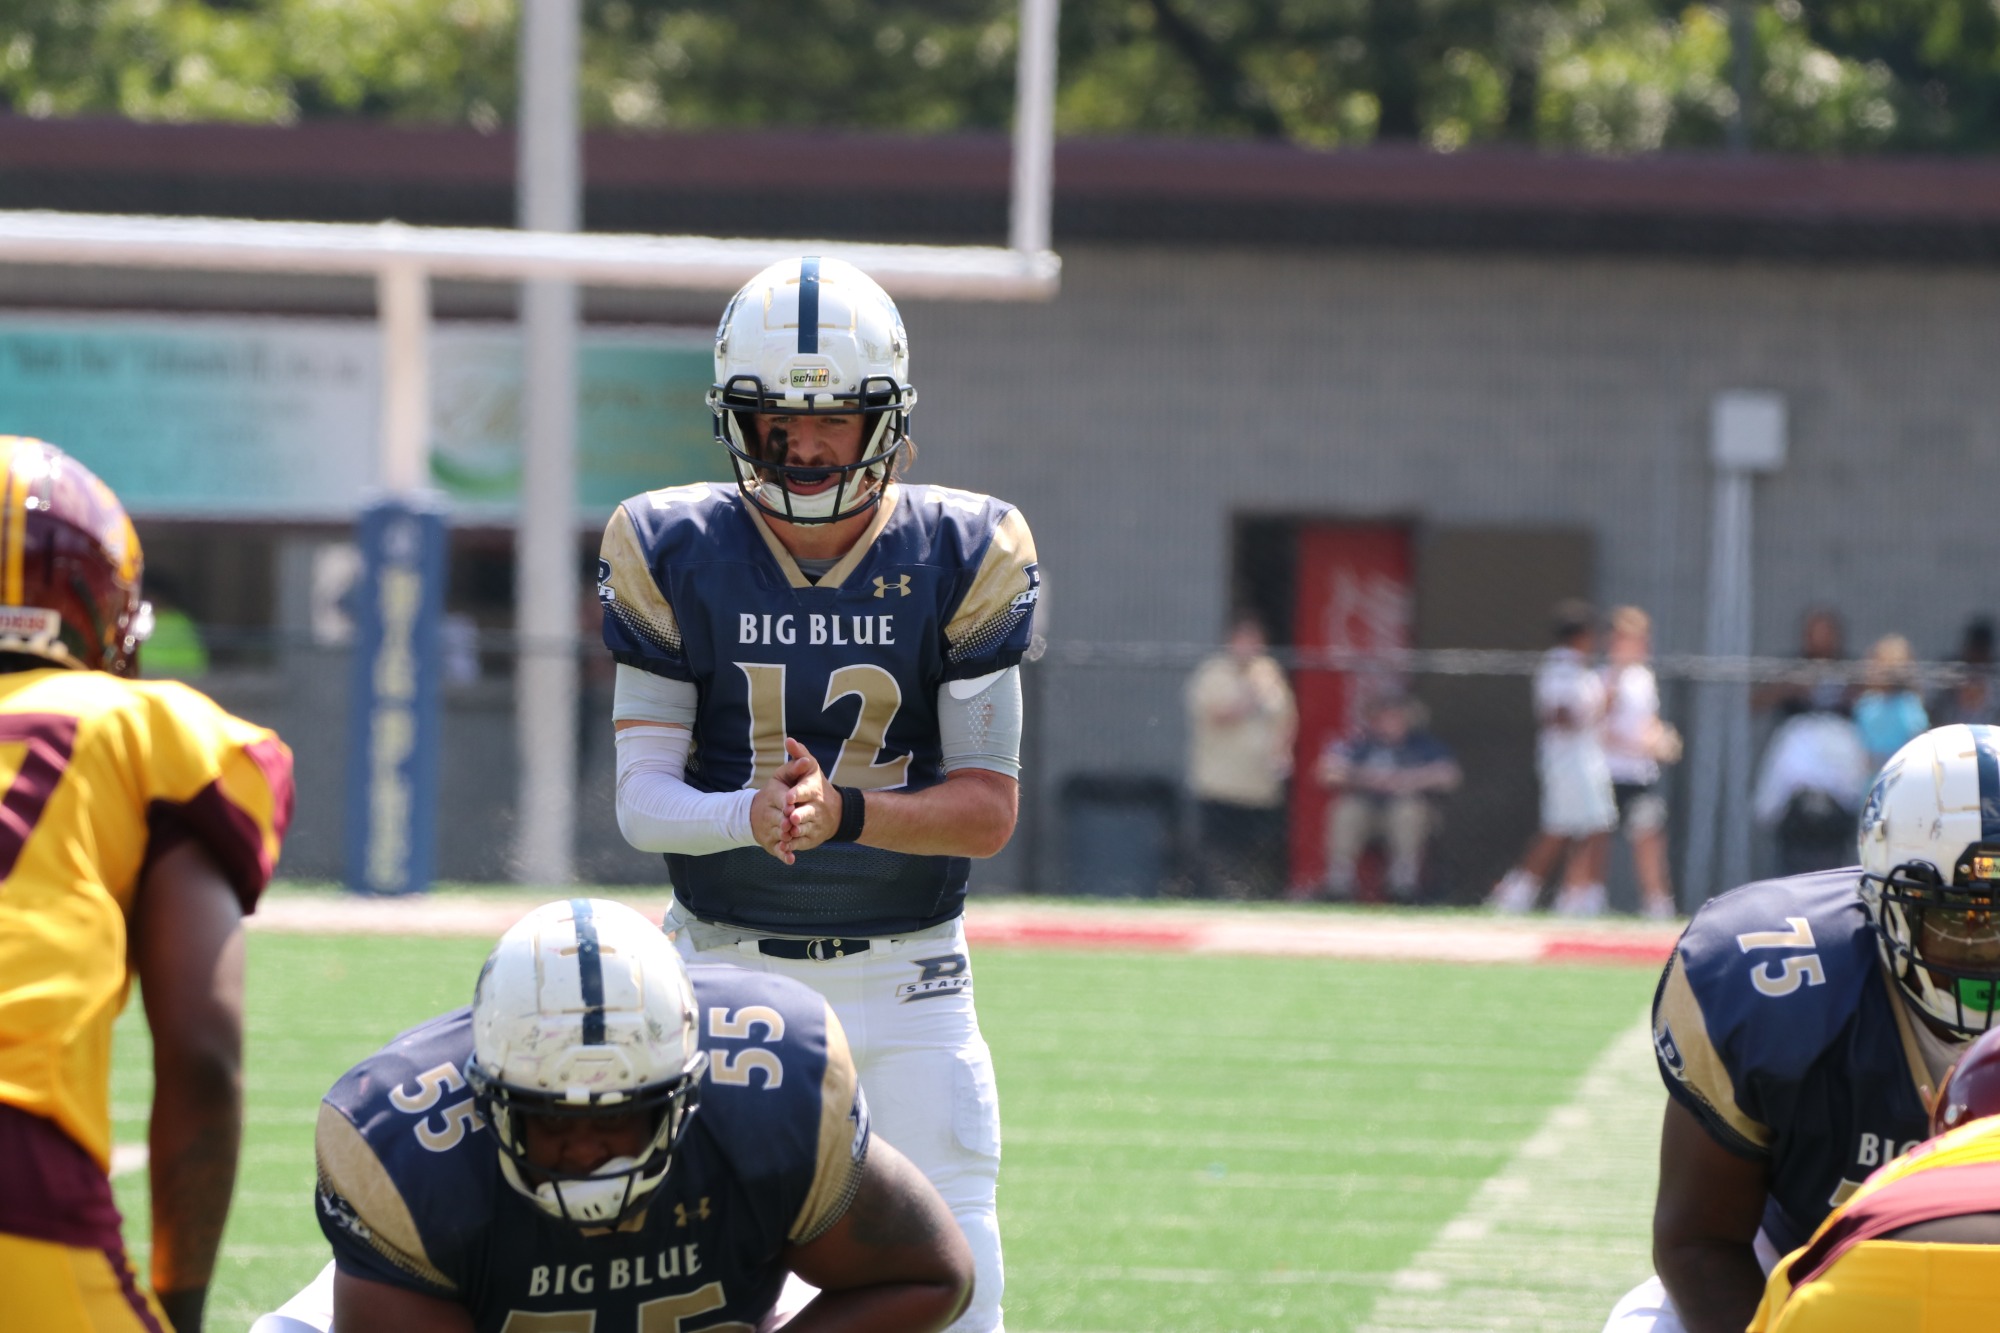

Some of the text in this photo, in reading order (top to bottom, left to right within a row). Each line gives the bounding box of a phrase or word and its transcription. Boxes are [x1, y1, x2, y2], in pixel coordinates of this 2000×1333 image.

[793, 373, 827, 383] schutt
[739, 613, 896, 645] BIG BLUE
[732, 661, 914, 793] 12
[906, 978, 971, 993] STATE
[1736, 917, 1826, 997] 75
[708, 1005, 785, 1091] 55
[387, 1061, 486, 1153] 55
[529, 1243, 702, 1297] BIG BLUE
